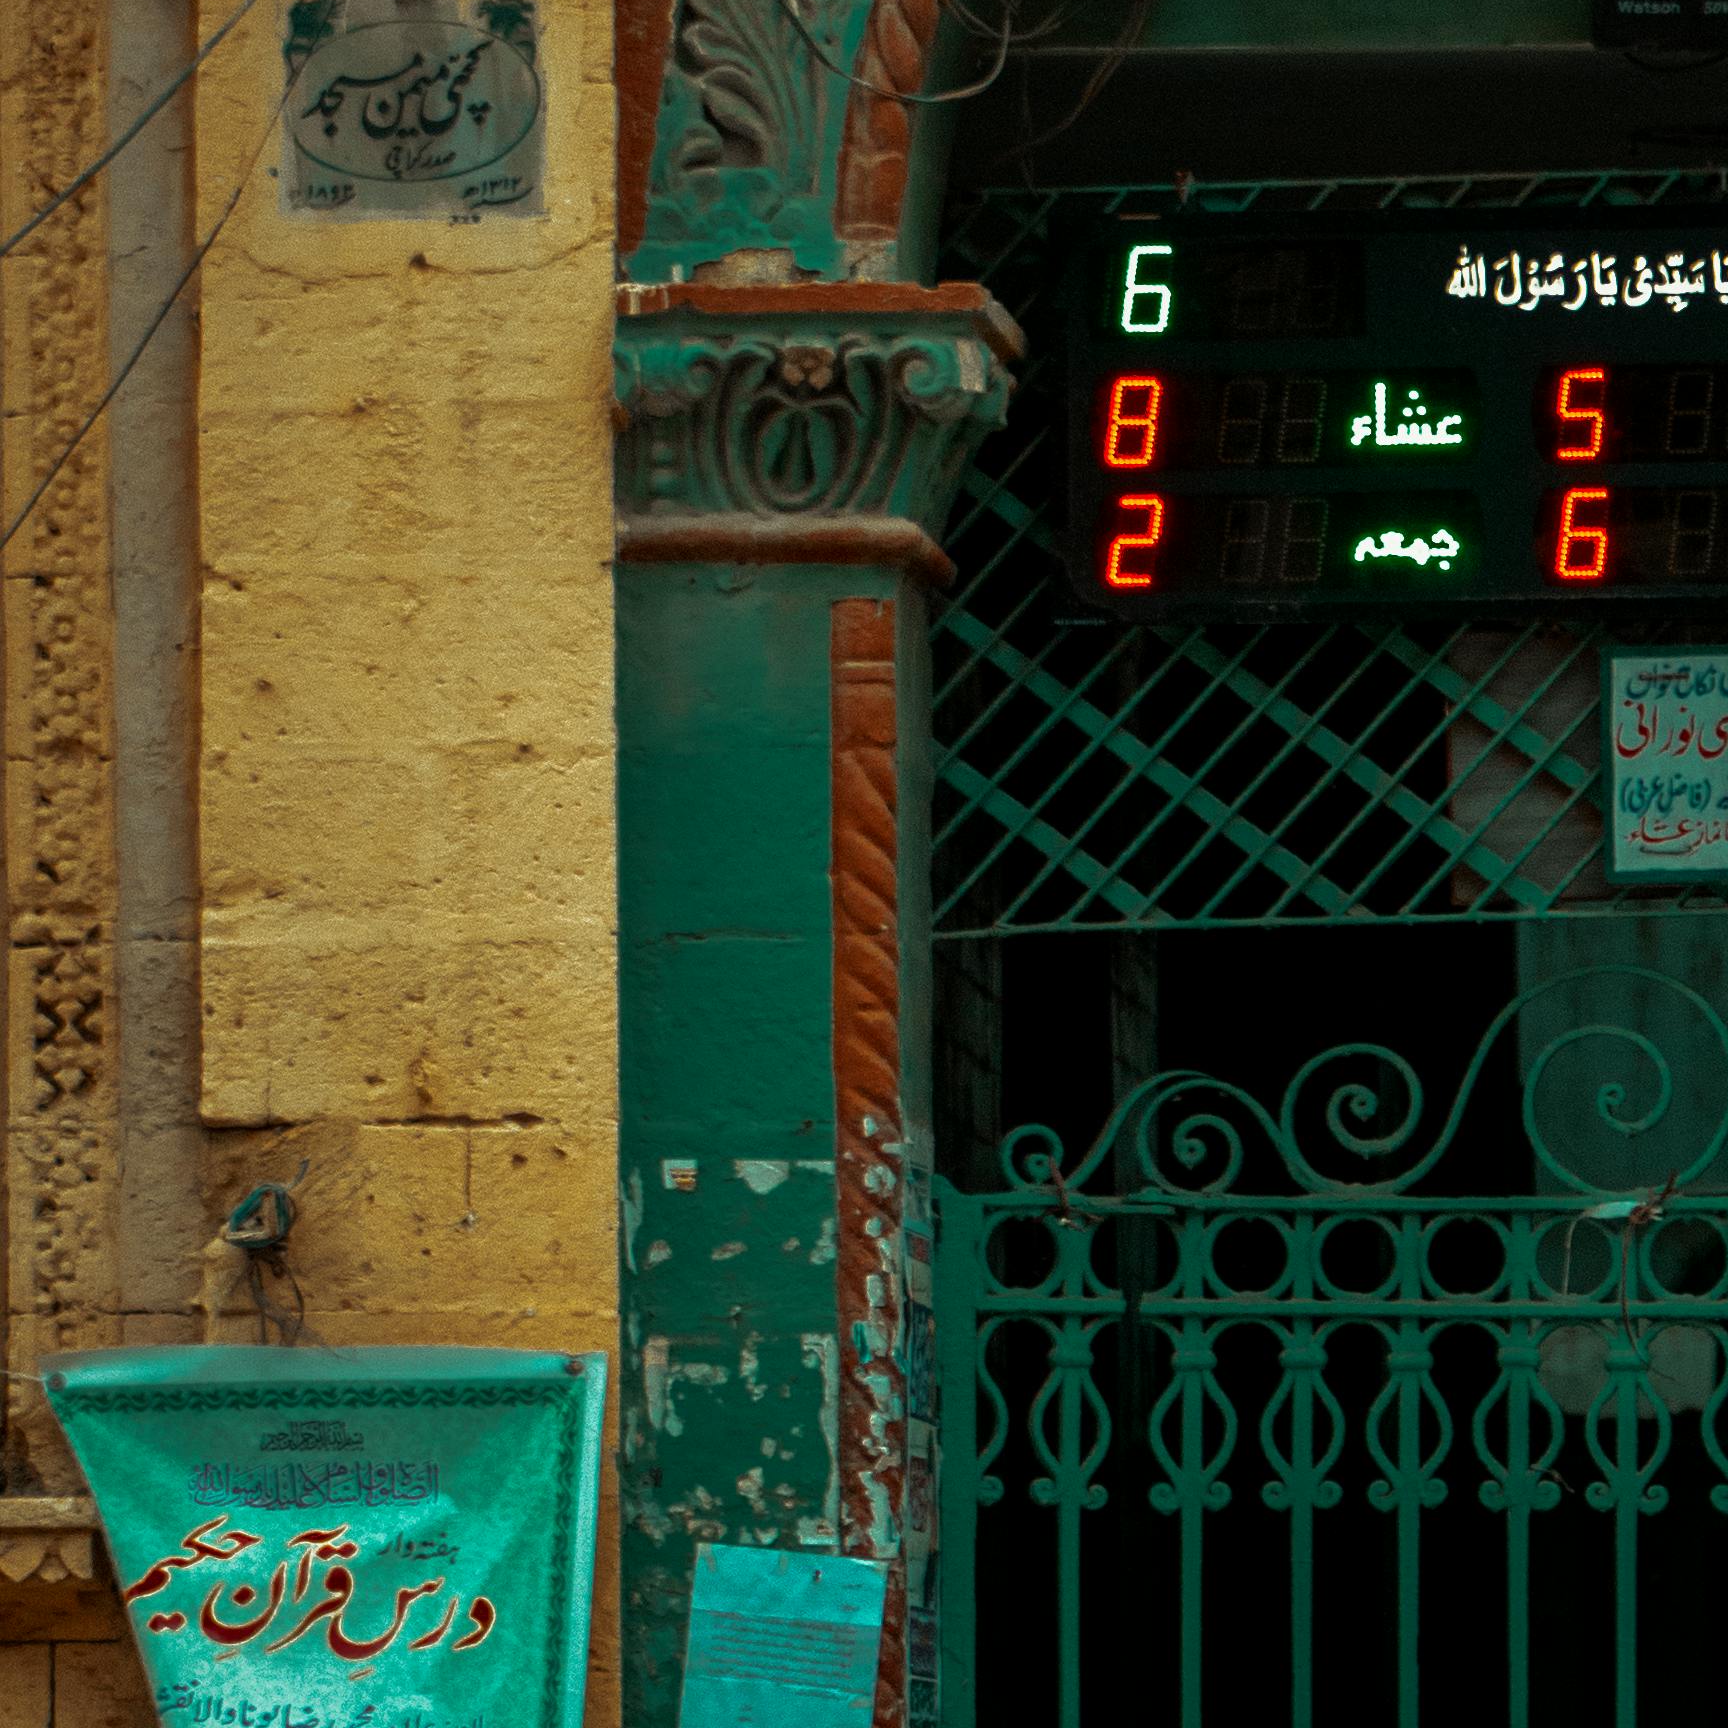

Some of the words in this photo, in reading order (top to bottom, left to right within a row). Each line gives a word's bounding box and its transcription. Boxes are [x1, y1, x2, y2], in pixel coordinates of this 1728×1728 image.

[1617, 0, 1681, 14] Watson
[301, 53, 423, 137] مسجد
[1120, 245, 1172, 332] 6
[1105, 376, 1163, 468] 8
[1351, 383, 1462, 446] عشاء
[1557, 369, 1605, 460] 5
[1106, 495, 1164, 587] 2
[1558, 487, 1607, 578] 6
[1616, 700, 1696, 758] نورانی
[125, 1514, 262, 1633] حکیم
